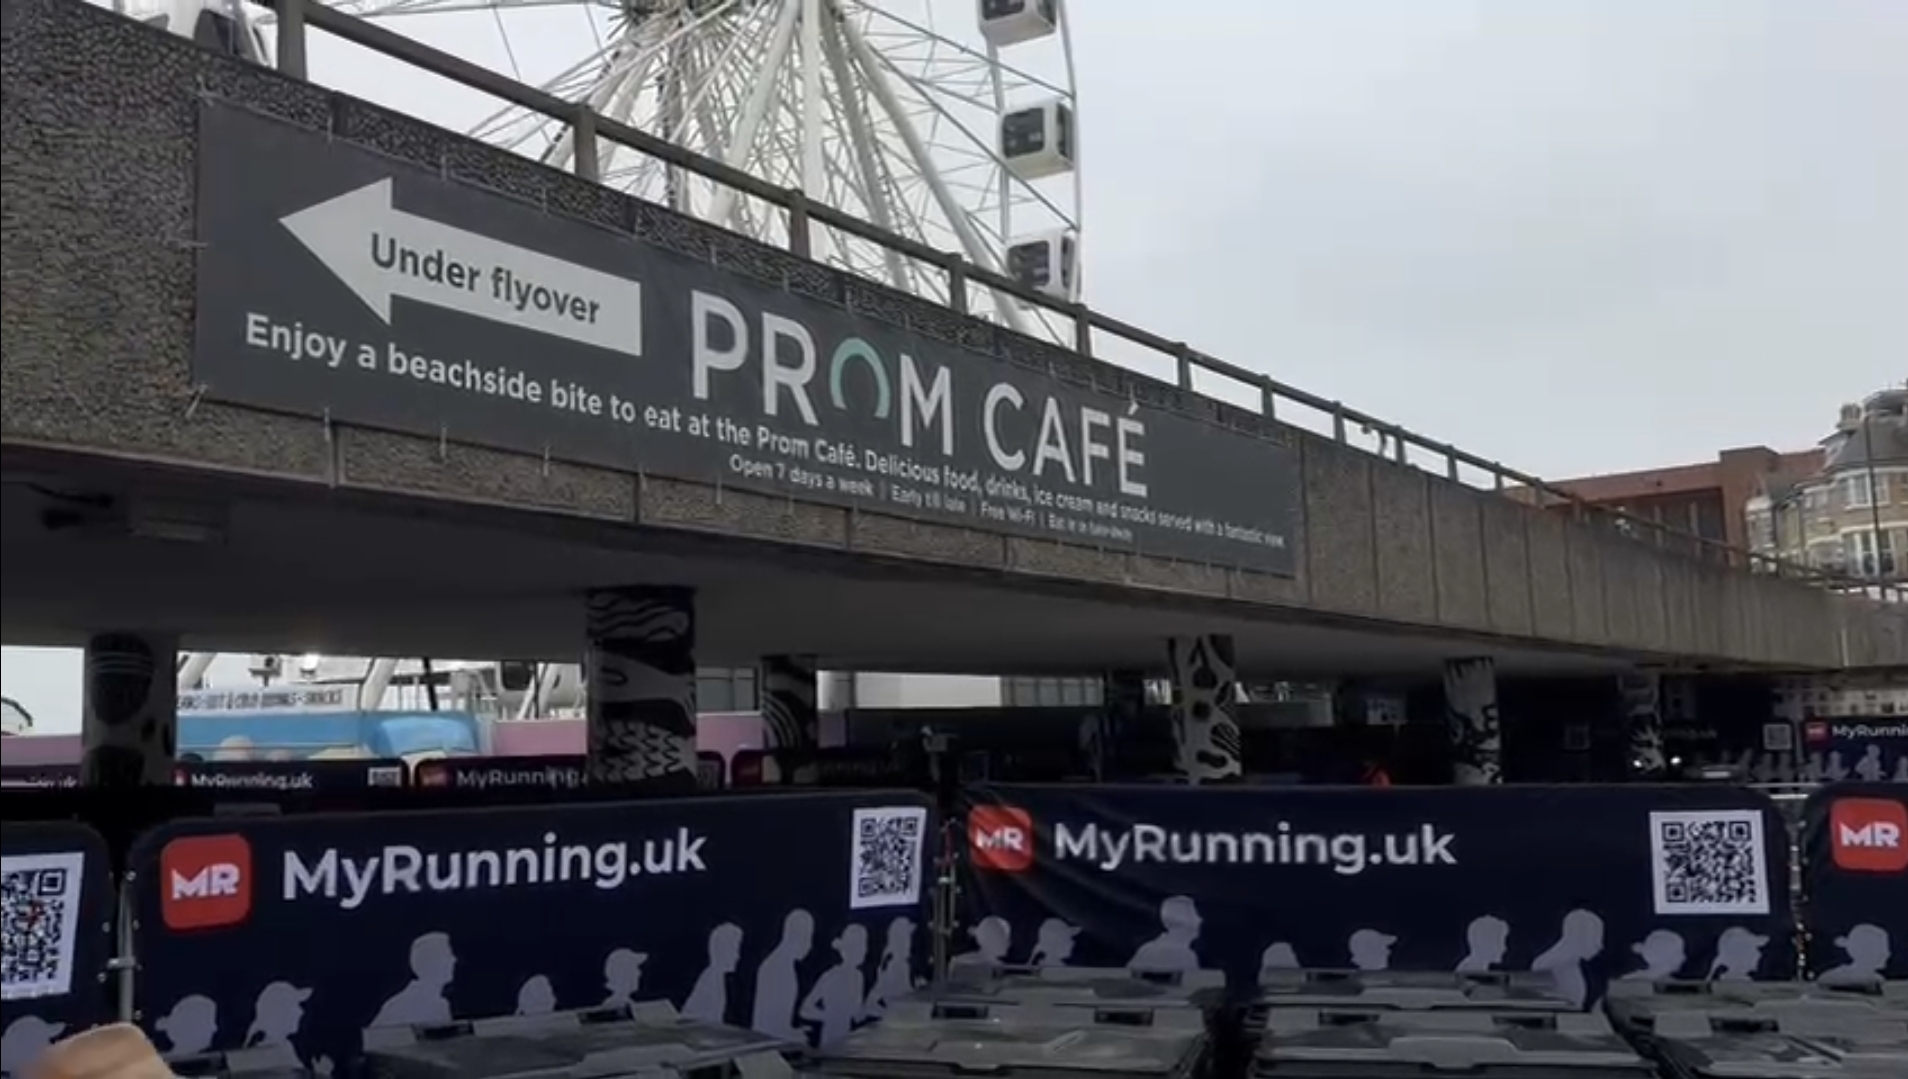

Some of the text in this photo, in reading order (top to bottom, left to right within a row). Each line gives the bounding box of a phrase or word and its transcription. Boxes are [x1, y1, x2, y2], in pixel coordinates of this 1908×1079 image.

[371, 232, 600, 324] Under flyover
[245, 312, 347, 368] Enjoy
[357, 343, 377, 370] a
[388, 342, 542, 403] beachside
[551, 379, 603, 416] bite
[609, 395, 636, 423] to
[644, 405, 681, 432] eat
[688, 413, 711, 438] at
[716, 417, 751, 447] the
[757, 424, 810, 460] Prom
[814, 437, 862, 469] Café.
[864, 448, 940, 485] Delicious
[943, 464, 983, 497] food,
[985, 472, 1032, 504] drinks,
[1034, 482, 1053, 508] ice
[1055, 492, 1093, 513] cream
[1096, 500, 1118, 519] and
[1119, 504, 1157, 526] snacks
[691, 289, 1148, 498] PROM CAFÉ
[729, 453, 774, 479] Open
[775, 461, 786, 480] 7
[789, 466, 823, 489] days
[826, 474, 835, 491] a
[838, 476, 874, 497] week
[891, 483, 922, 509] Early
[980, 500, 1005, 521] Free
[1832, 723, 1908, 739] MyRunni
[456, 766, 588, 789] MyRunning.
[976, 826, 1025, 851] MR
[1053, 821, 1458, 874] MyRunning.uk
[1839, 821, 1900, 847] MR
[171, 862, 240, 899] MR
[283, 828, 707, 909] MyRunning.uk
